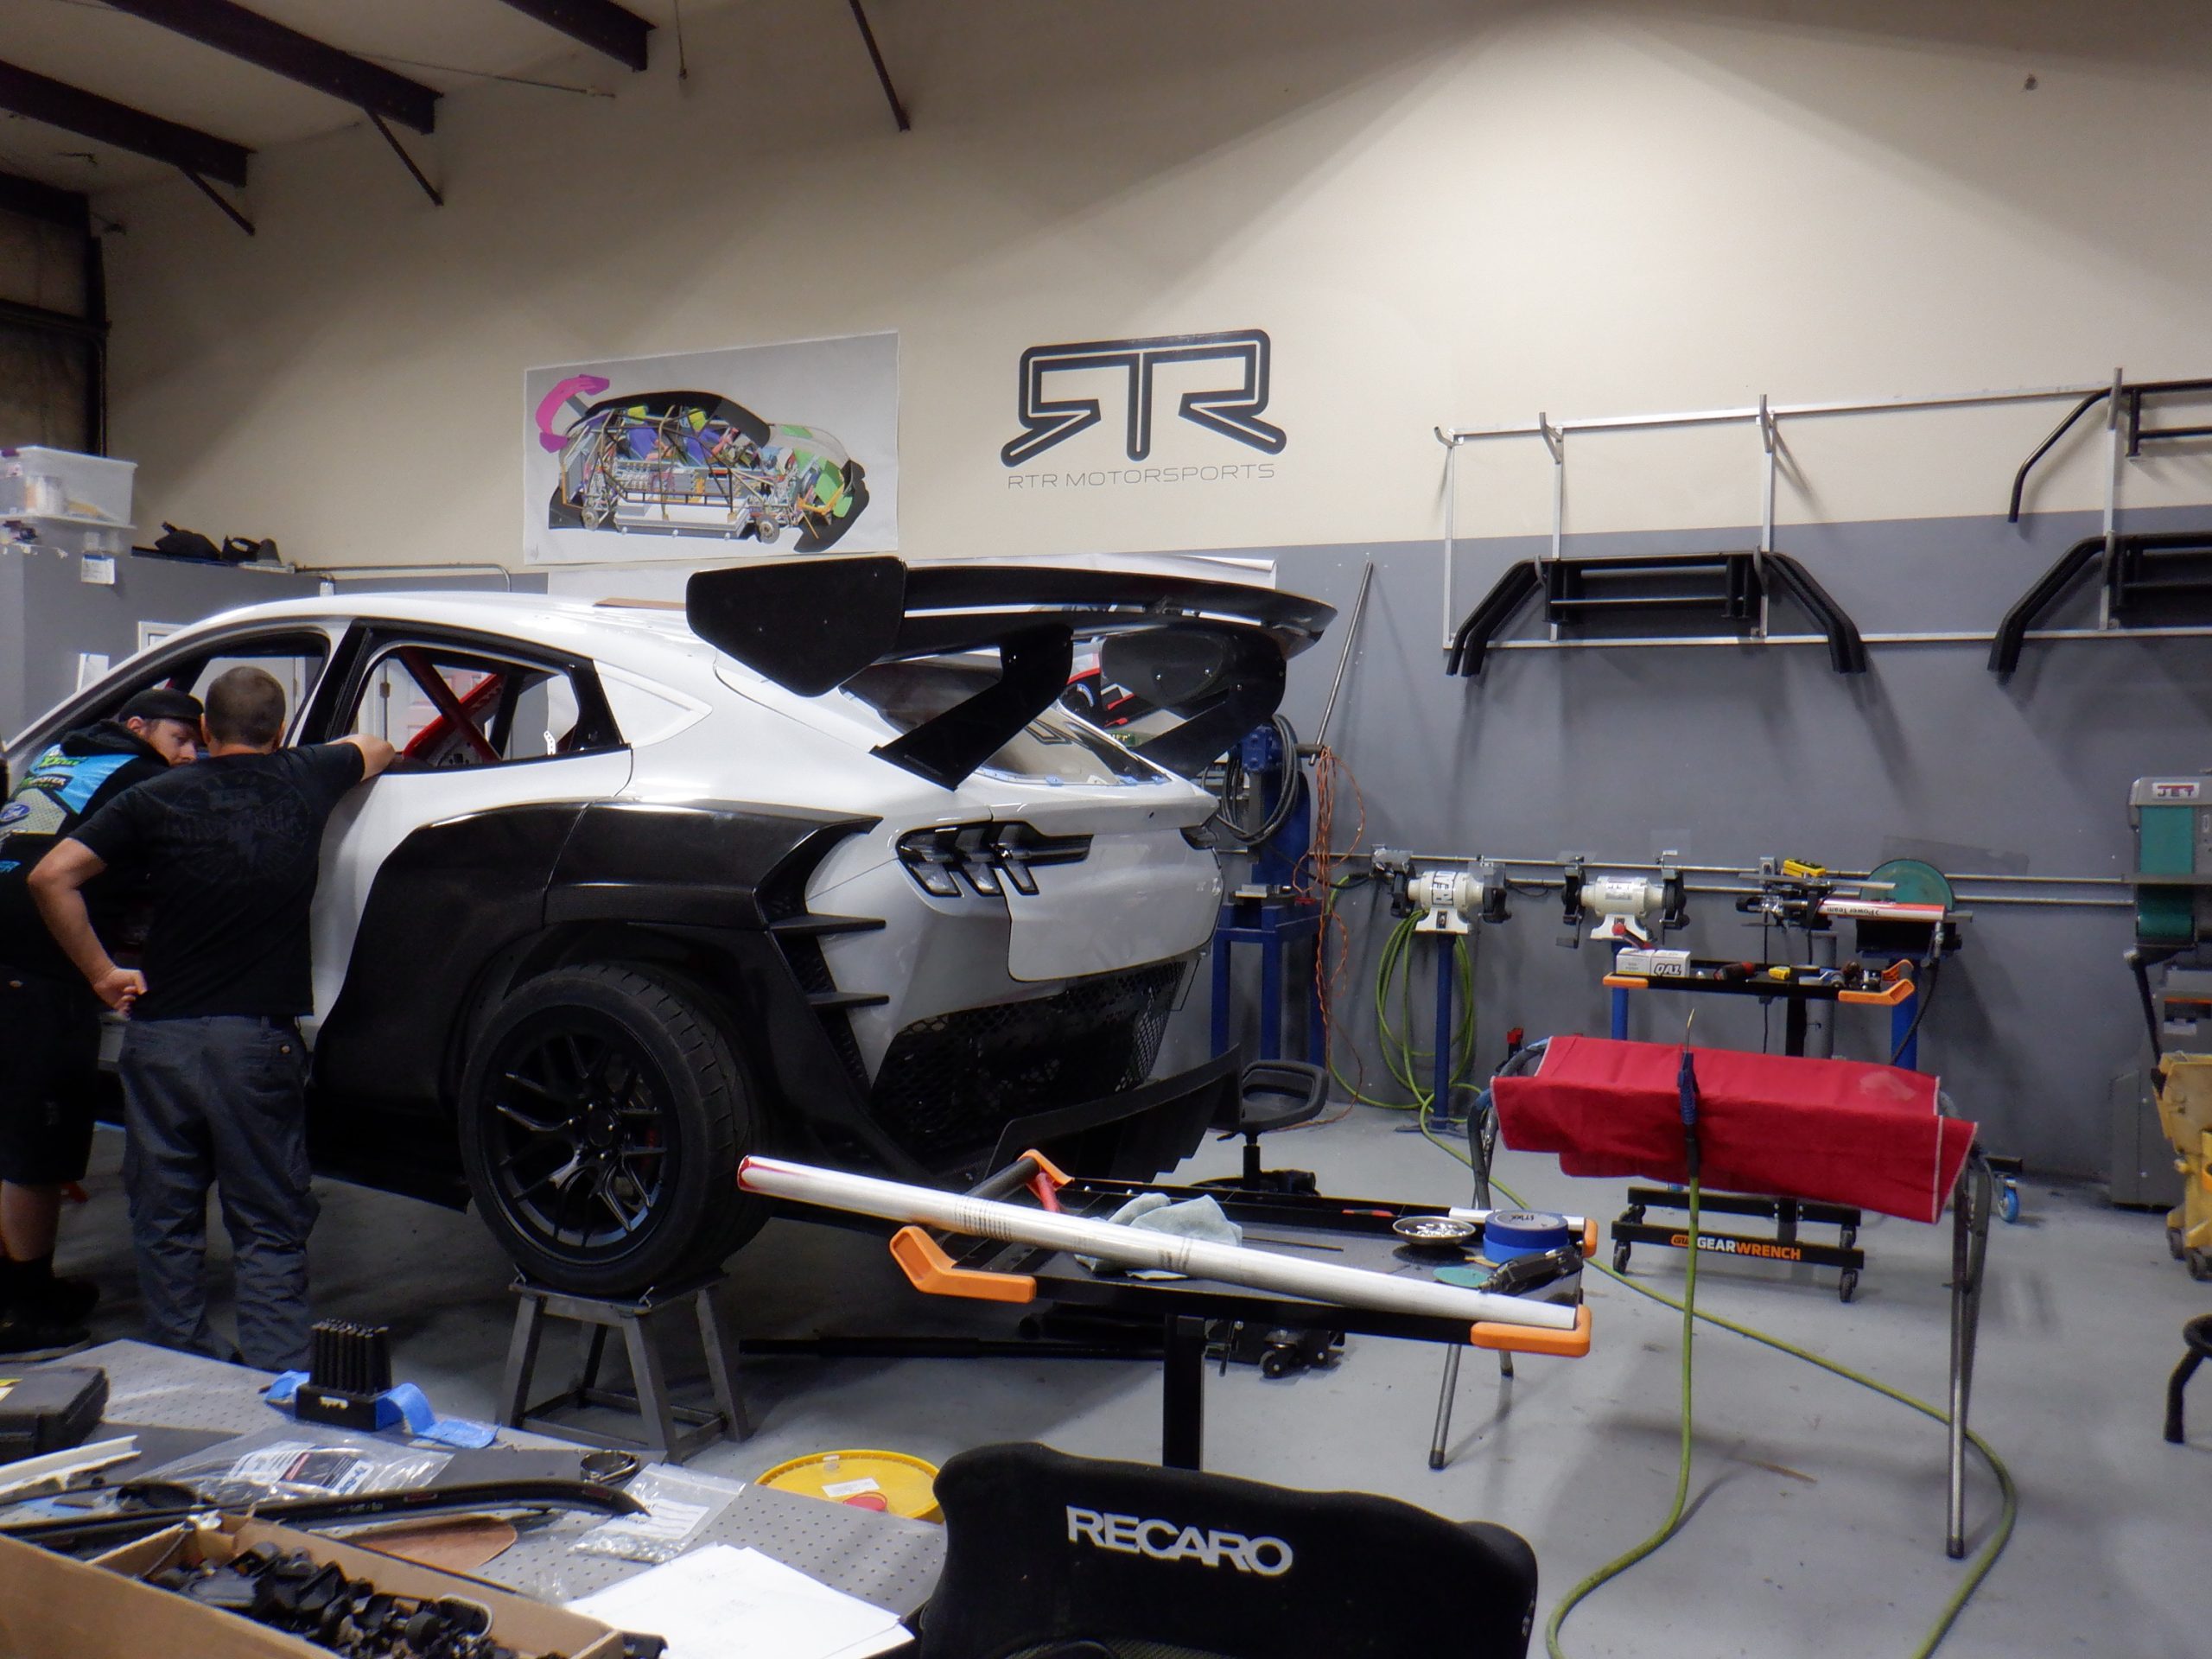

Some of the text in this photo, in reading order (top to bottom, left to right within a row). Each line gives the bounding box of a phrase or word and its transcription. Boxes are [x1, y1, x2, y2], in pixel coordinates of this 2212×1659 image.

[1001, 328, 1287, 467] RTR
[1007, 463, 1275, 490] RTR MOTORSPORTS
[2157, 785, 2195, 798] JET
[1654, 963, 1681, 977] QA1
[1696, 1236, 1802, 1262] GEARWRENCH
[1065, 1504, 1294, 1576] RECARO
